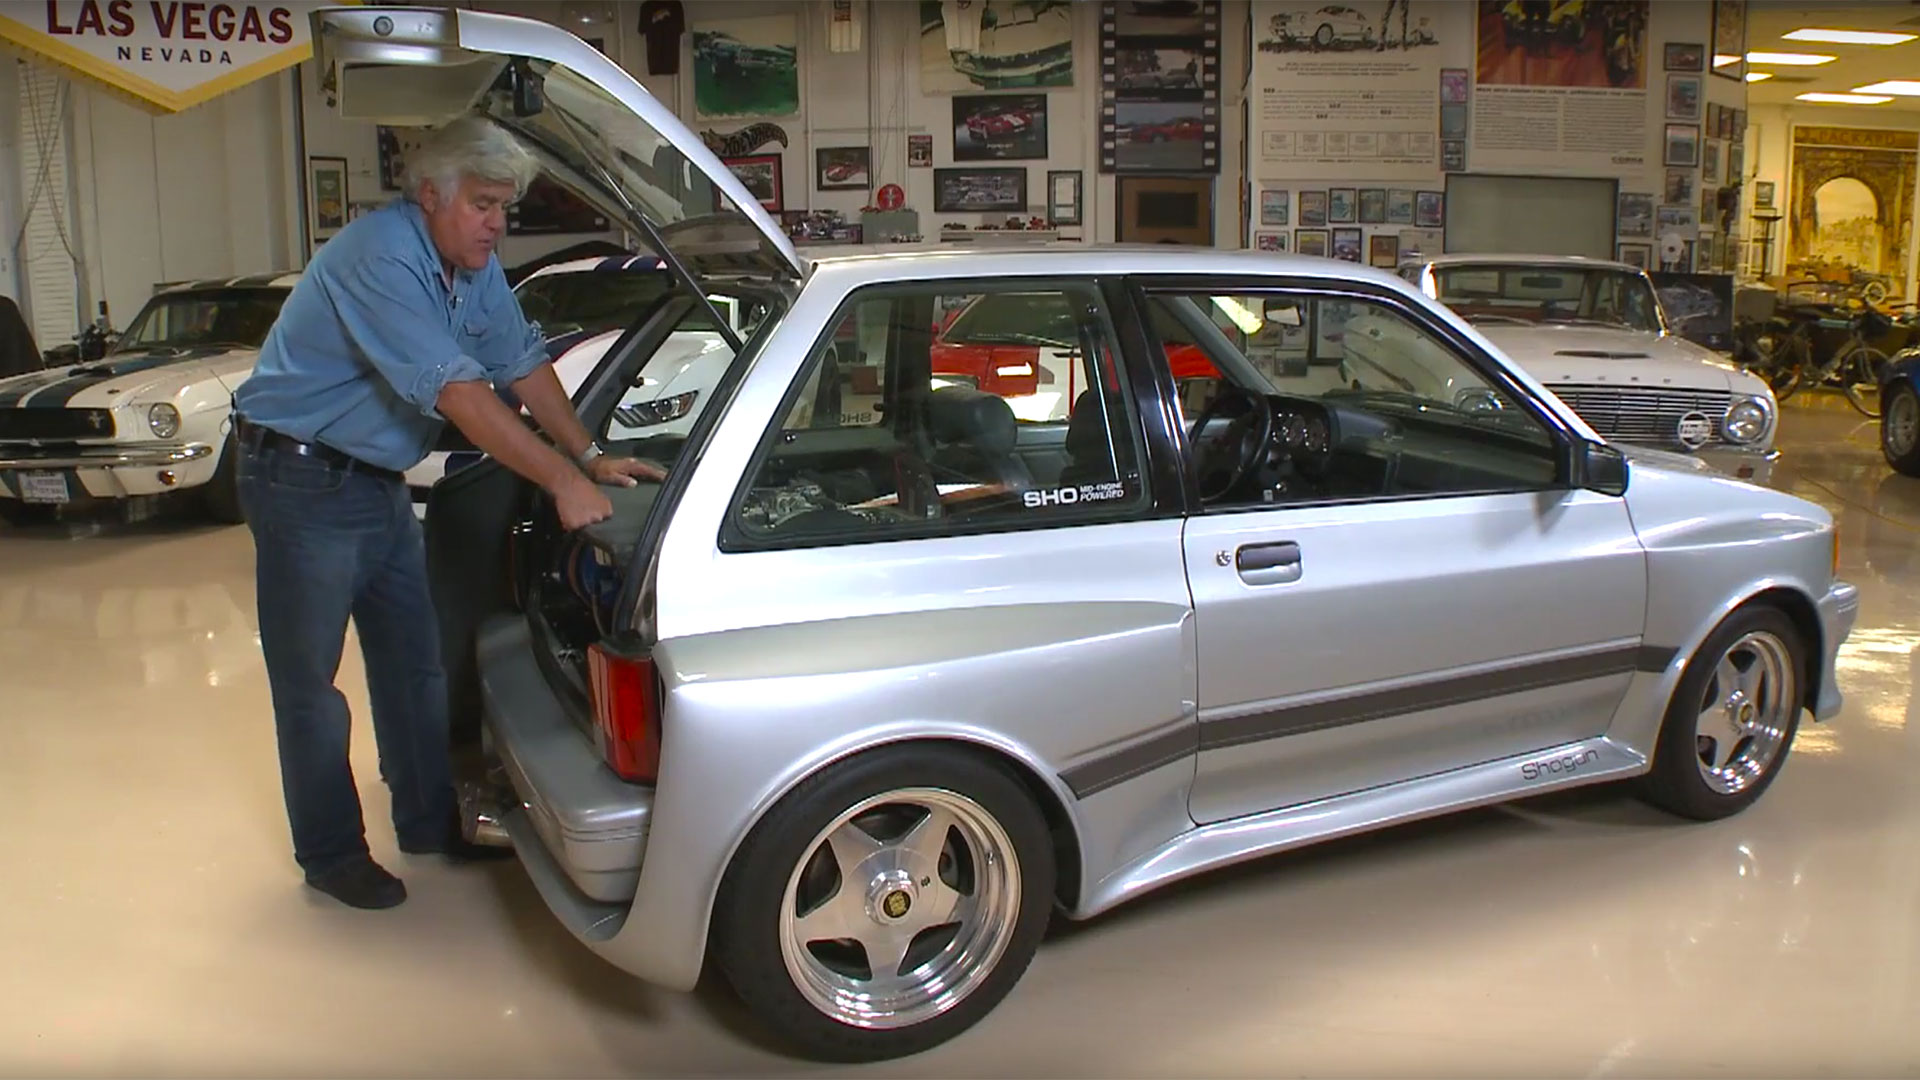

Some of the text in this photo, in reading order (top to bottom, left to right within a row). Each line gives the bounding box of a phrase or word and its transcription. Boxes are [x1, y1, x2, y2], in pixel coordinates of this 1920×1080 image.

[48, 0, 293, 43] LAS VEGAS
[118, 46, 233, 65] NEVADA
[1023, 487, 1078, 508] SHO
[1080, 489, 1124, 502] POWERED
[1522, 749, 1599, 781] Shogun
